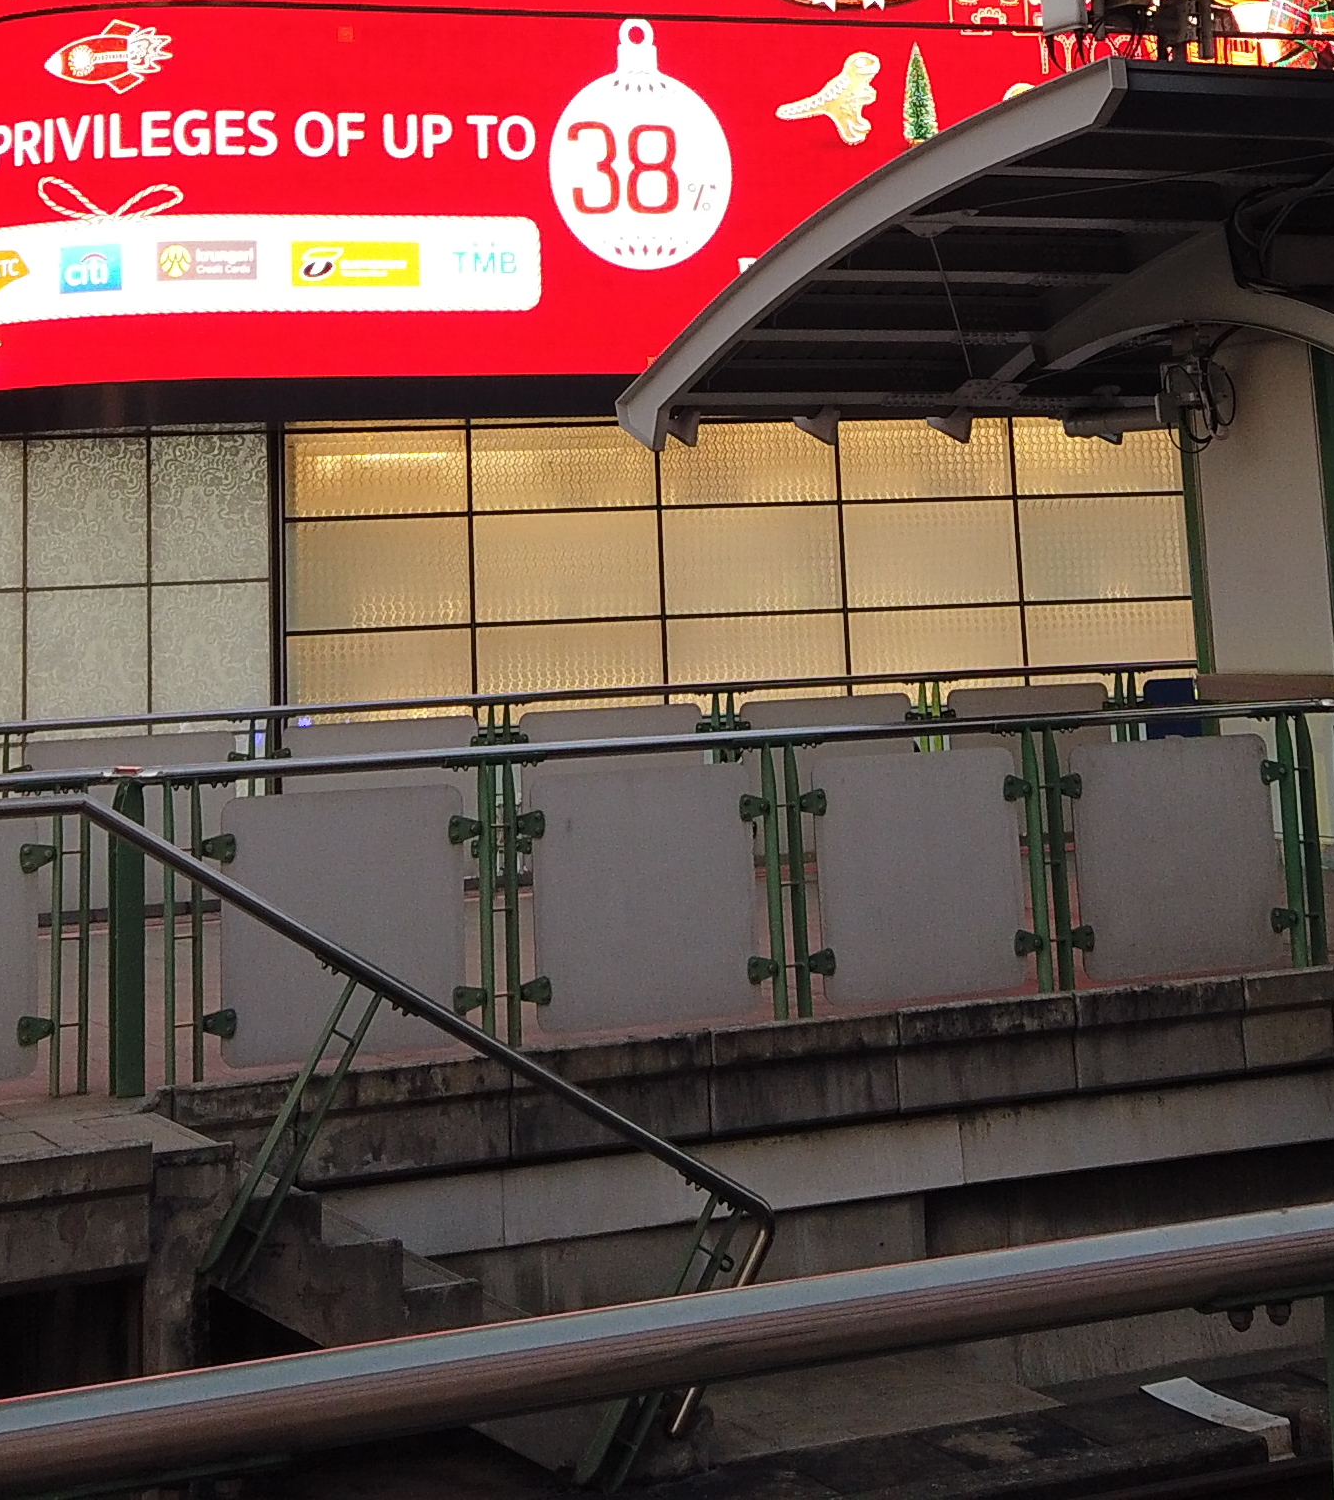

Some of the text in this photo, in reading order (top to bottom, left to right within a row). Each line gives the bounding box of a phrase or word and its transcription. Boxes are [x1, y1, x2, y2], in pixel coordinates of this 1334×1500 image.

[293, 111, 366, 158] OF
[382, 114, 453, 160] UP
[466, 114, 537, 160] TO
[64, 255, 109, 286] citi
[452, 243, 517, 274] TMB
